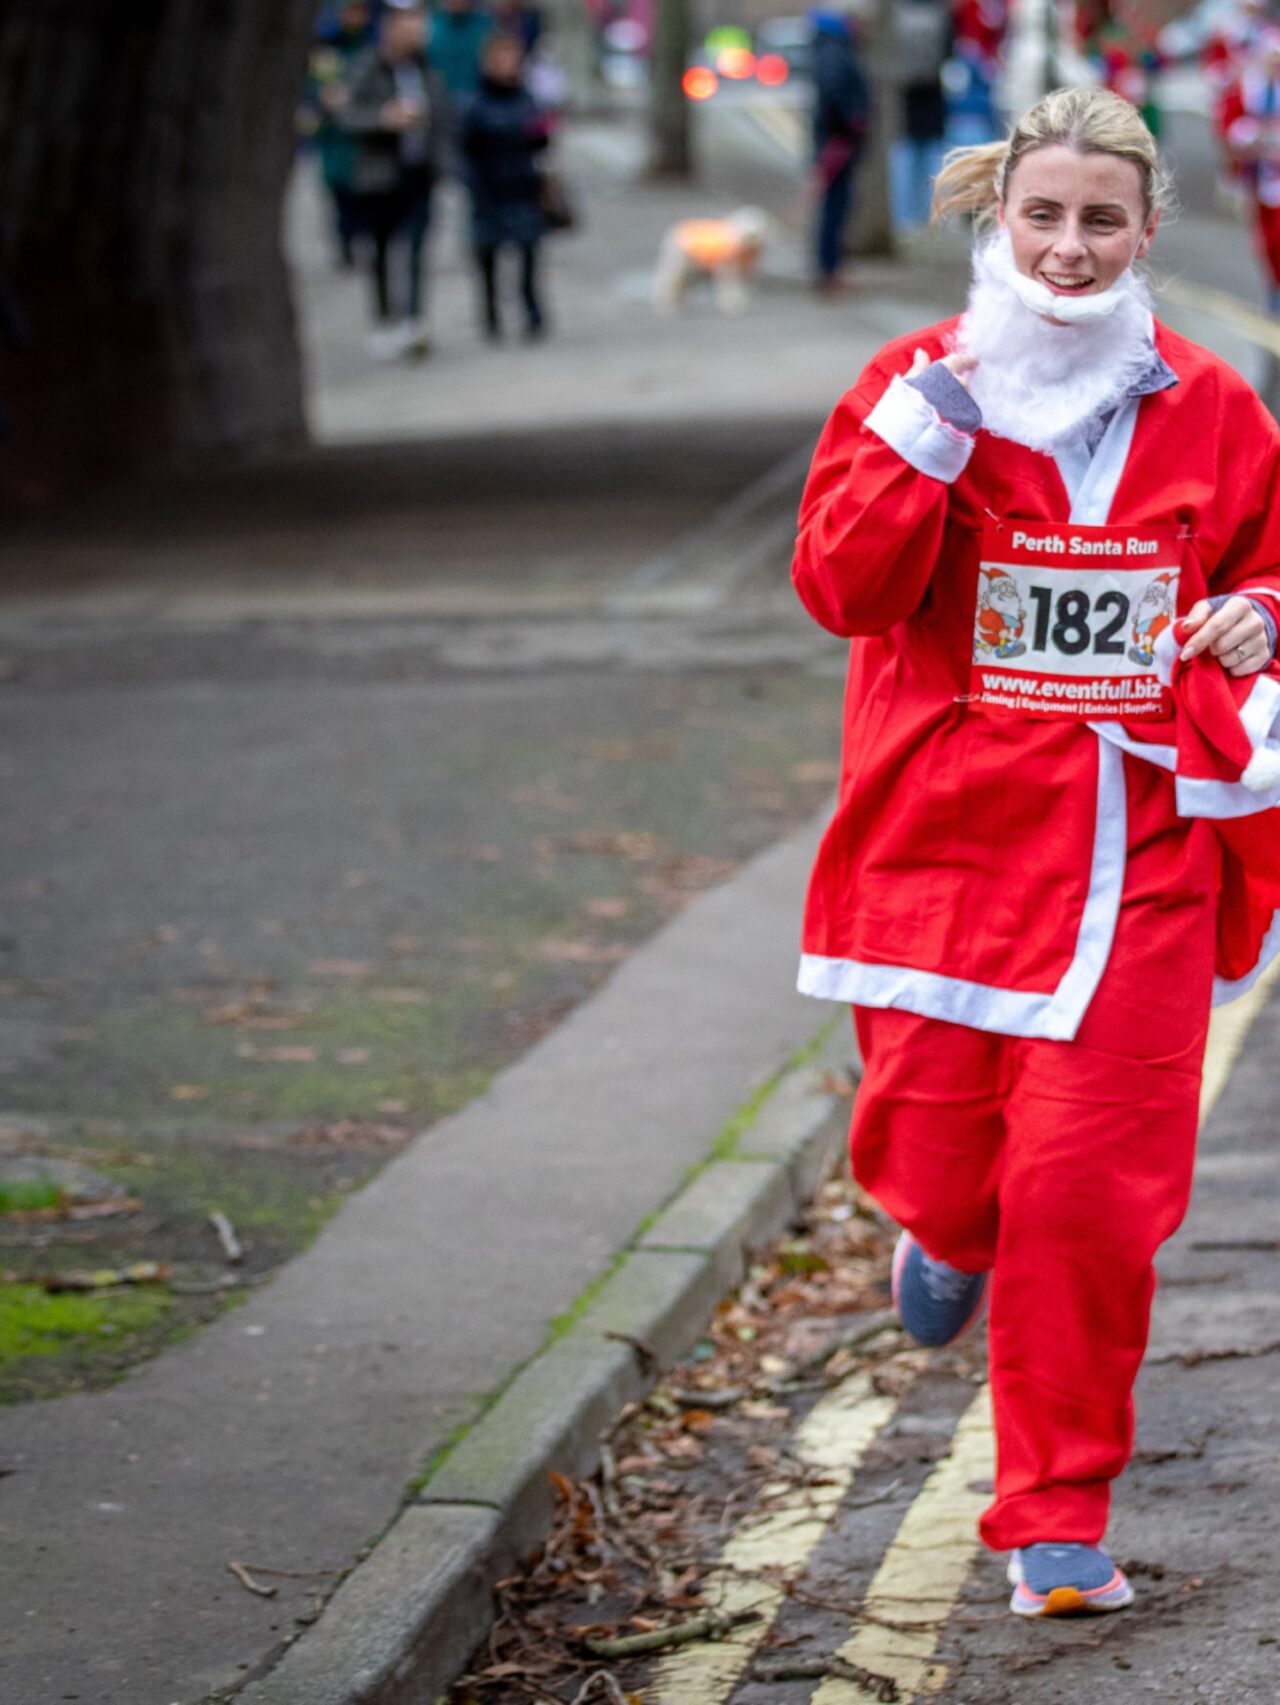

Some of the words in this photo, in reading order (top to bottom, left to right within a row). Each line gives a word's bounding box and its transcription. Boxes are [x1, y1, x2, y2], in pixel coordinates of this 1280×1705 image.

[1012, 532, 1065, 554] Perth
[1069, 537, 1122, 555] Santa
[1126, 538, 1158, 554] Run
[1030, 585, 1129, 655] 182
[982, 674, 1162, 700] www.eventfull.biz
